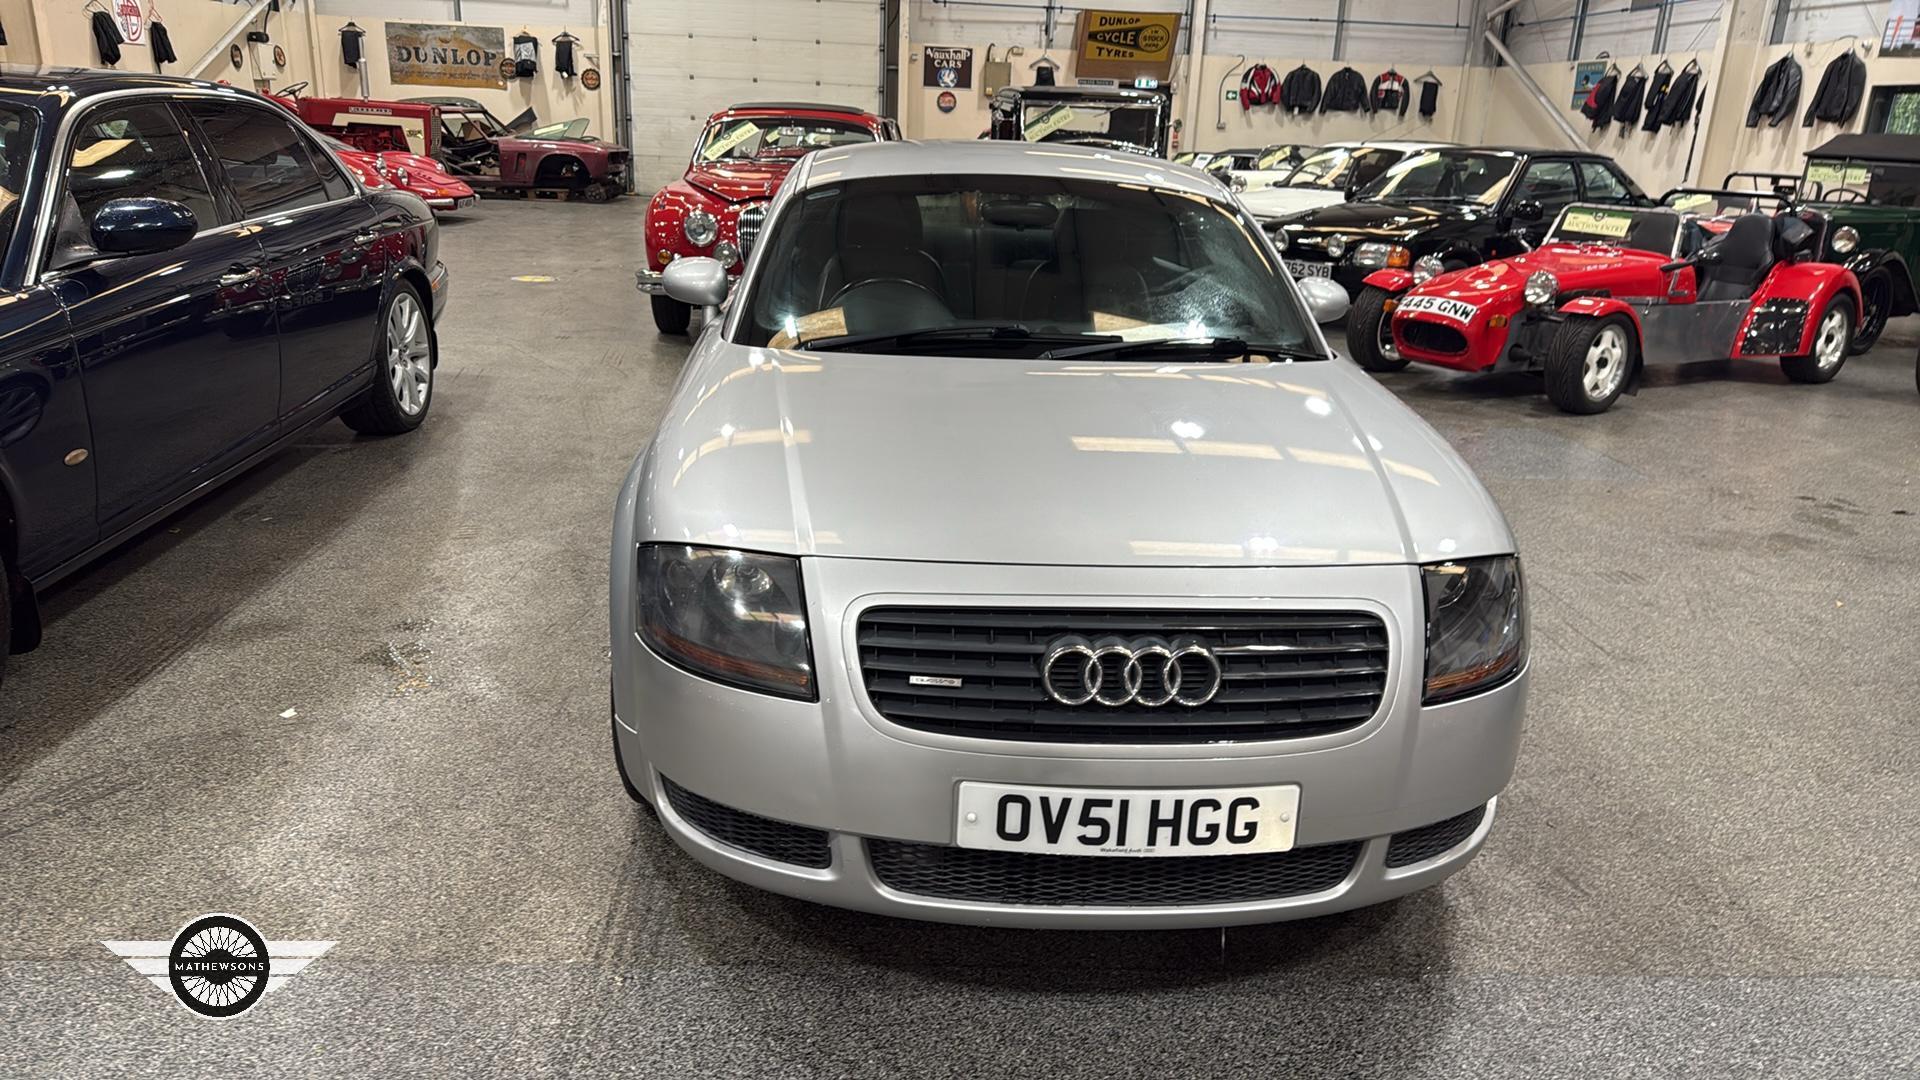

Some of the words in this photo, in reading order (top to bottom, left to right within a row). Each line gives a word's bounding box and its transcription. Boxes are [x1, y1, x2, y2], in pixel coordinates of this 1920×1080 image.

[1100, 16, 1140, 26] DUNLOP
[1097, 31, 1135, 45] CYCLE
[396, 46, 497, 66] DUNLOP
[926, 48, 970, 60] Vauxhall
[1096, 46, 1134, 58] TYRES
[934, 60, 962, 68] CARS
[1568, 220, 1598, 229] AUCTION
[1599, 223, 1624, 232] ENTRY
[1307, 264, 1329, 278] SYB
[1437, 299, 1474, 320] GNW
[996, 794, 1130, 846] OV51
[1147, 797, 1260, 846] HGG
